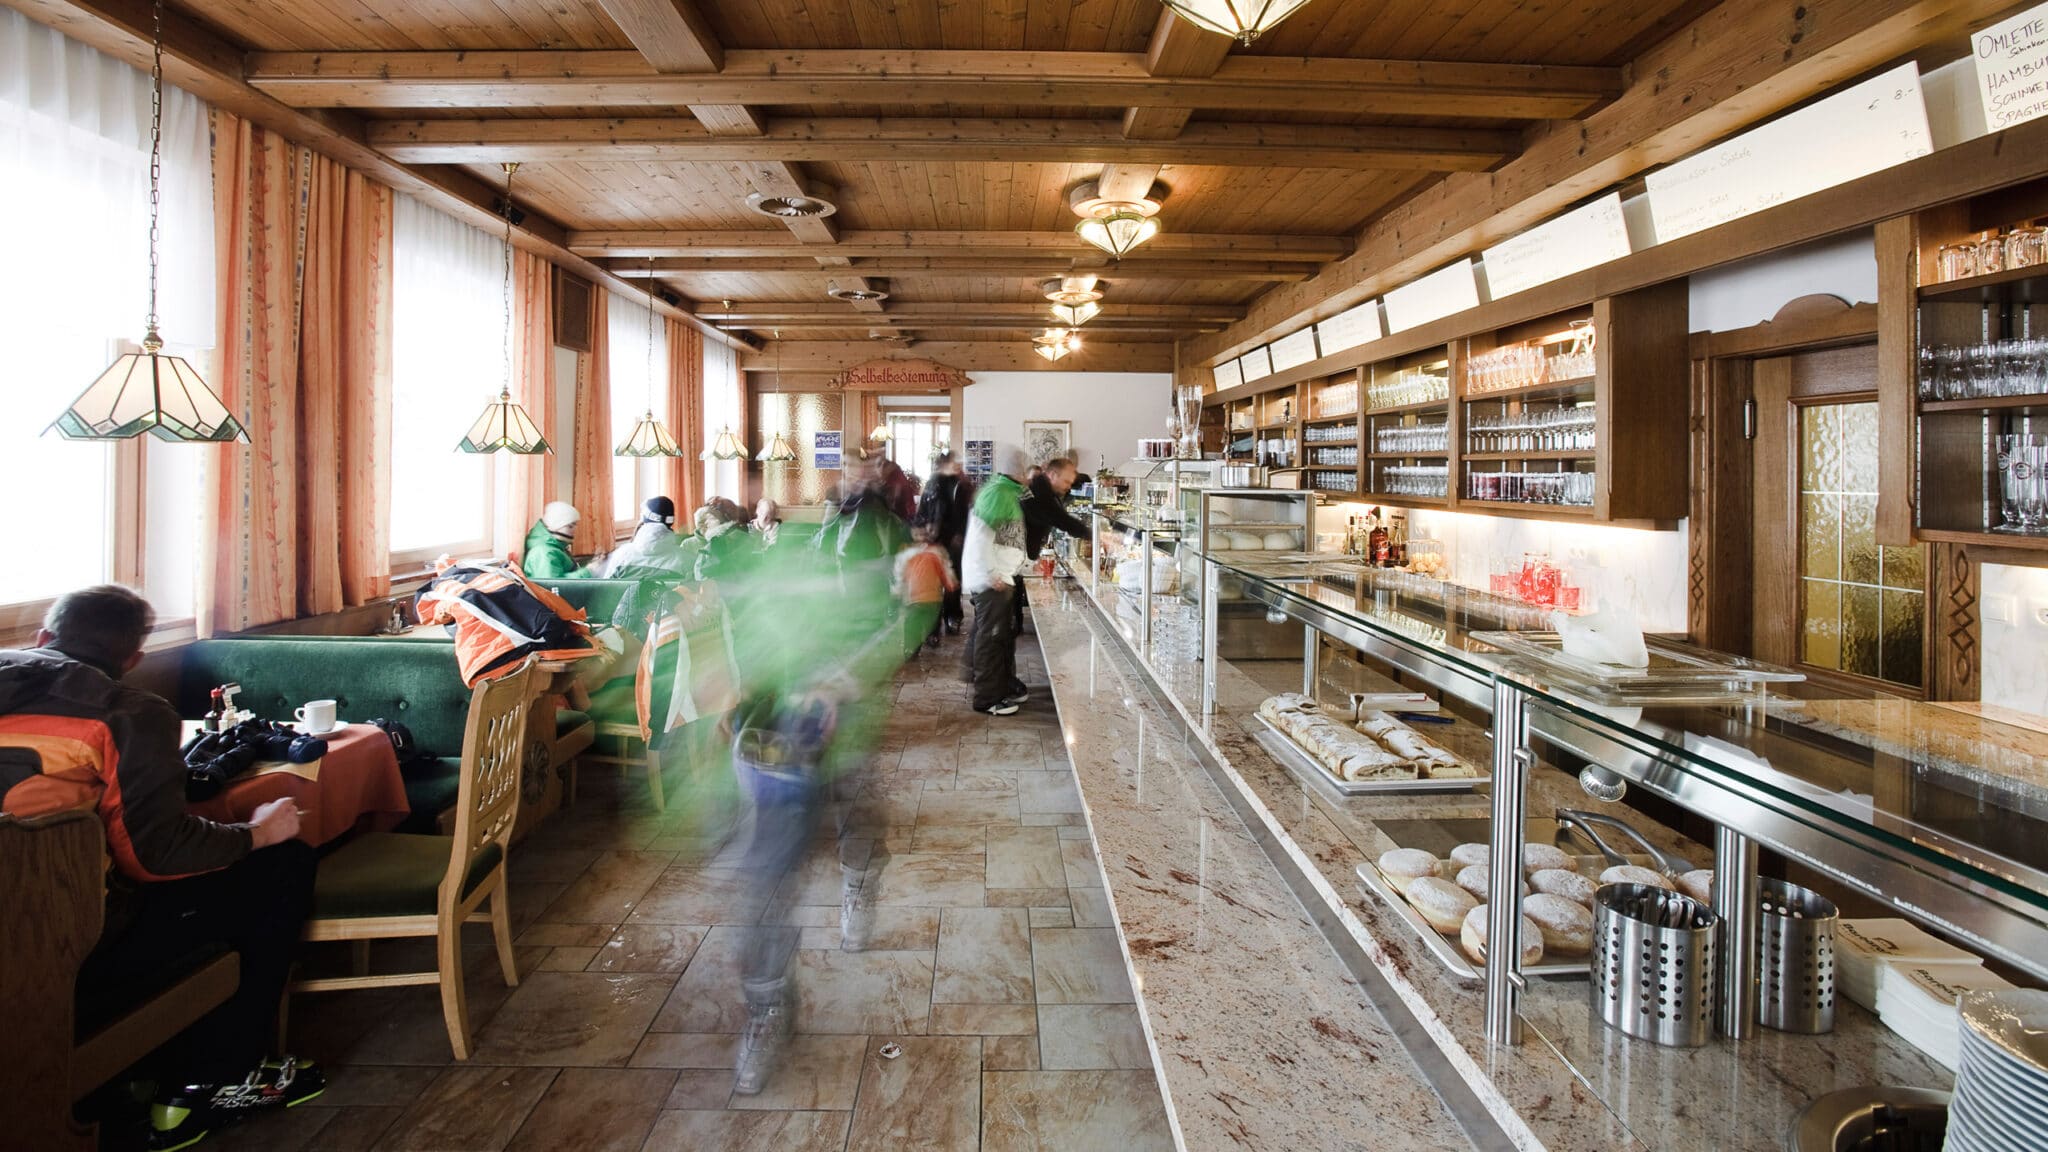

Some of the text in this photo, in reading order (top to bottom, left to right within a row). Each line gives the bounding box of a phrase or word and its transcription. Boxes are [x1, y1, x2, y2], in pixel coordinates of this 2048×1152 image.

[1979, 19, 2045, 59] OMLETTE
[1989, 81, 2048, 112] SCHINKE
[848, 367, 948, 387] Selbstbedienung
